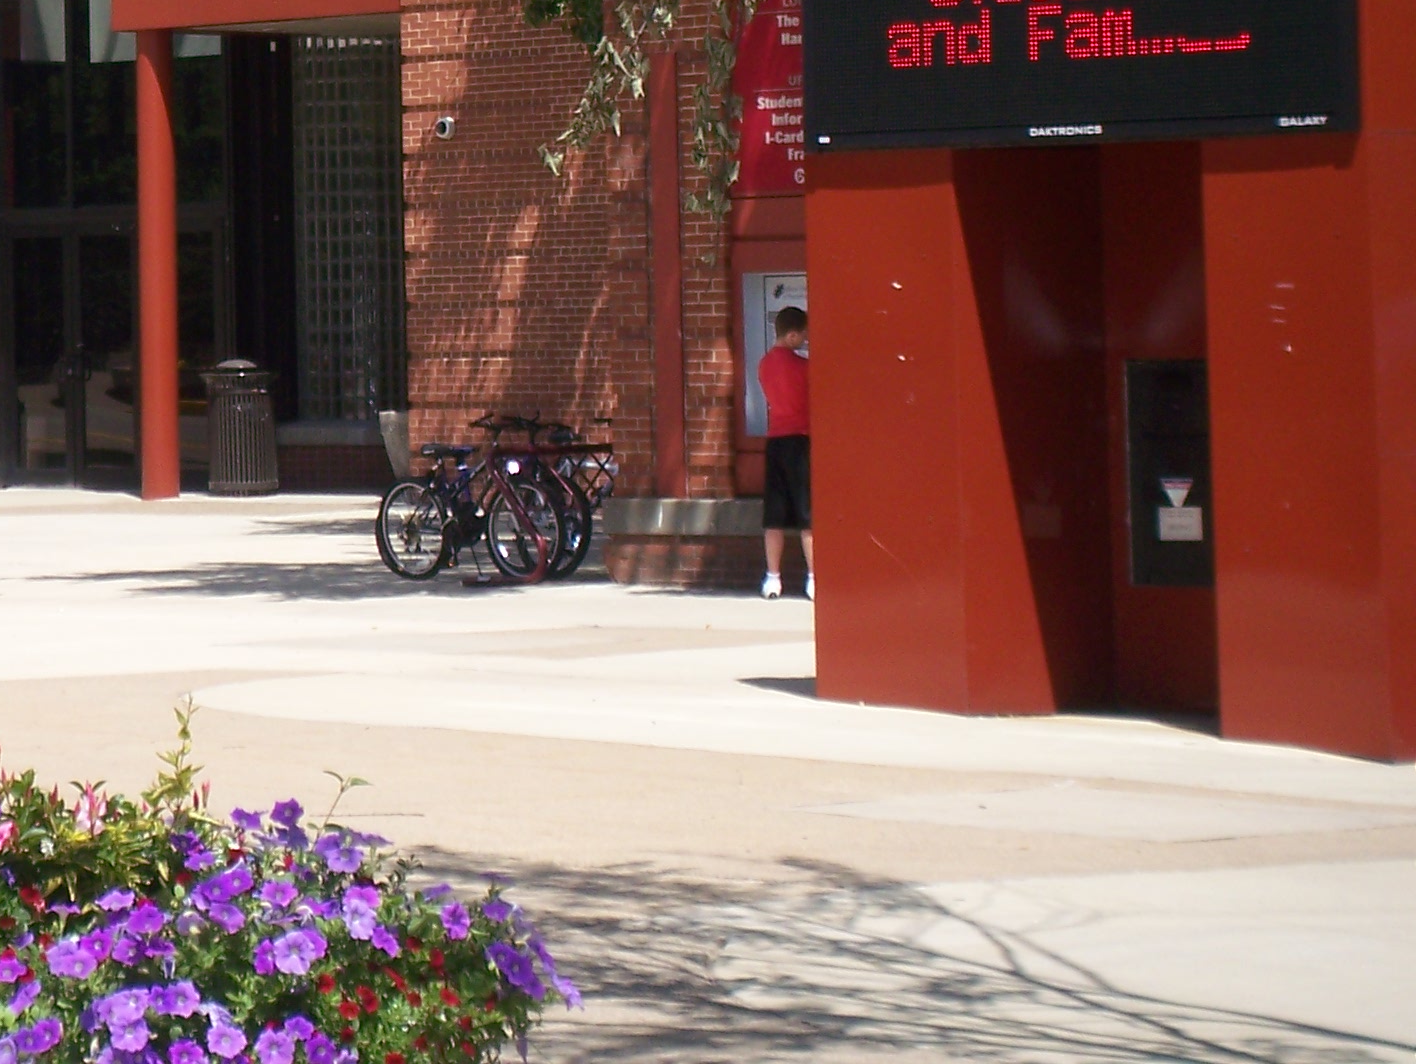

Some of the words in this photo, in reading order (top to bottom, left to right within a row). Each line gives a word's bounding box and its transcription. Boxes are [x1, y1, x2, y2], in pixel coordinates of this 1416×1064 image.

[777, 15, 799, 28] The
[888, 9, 992, 68] and
[1278, 116, 1329, 127] GALAXY
[1029, 124, 1103, 137] DAKTRONICS
